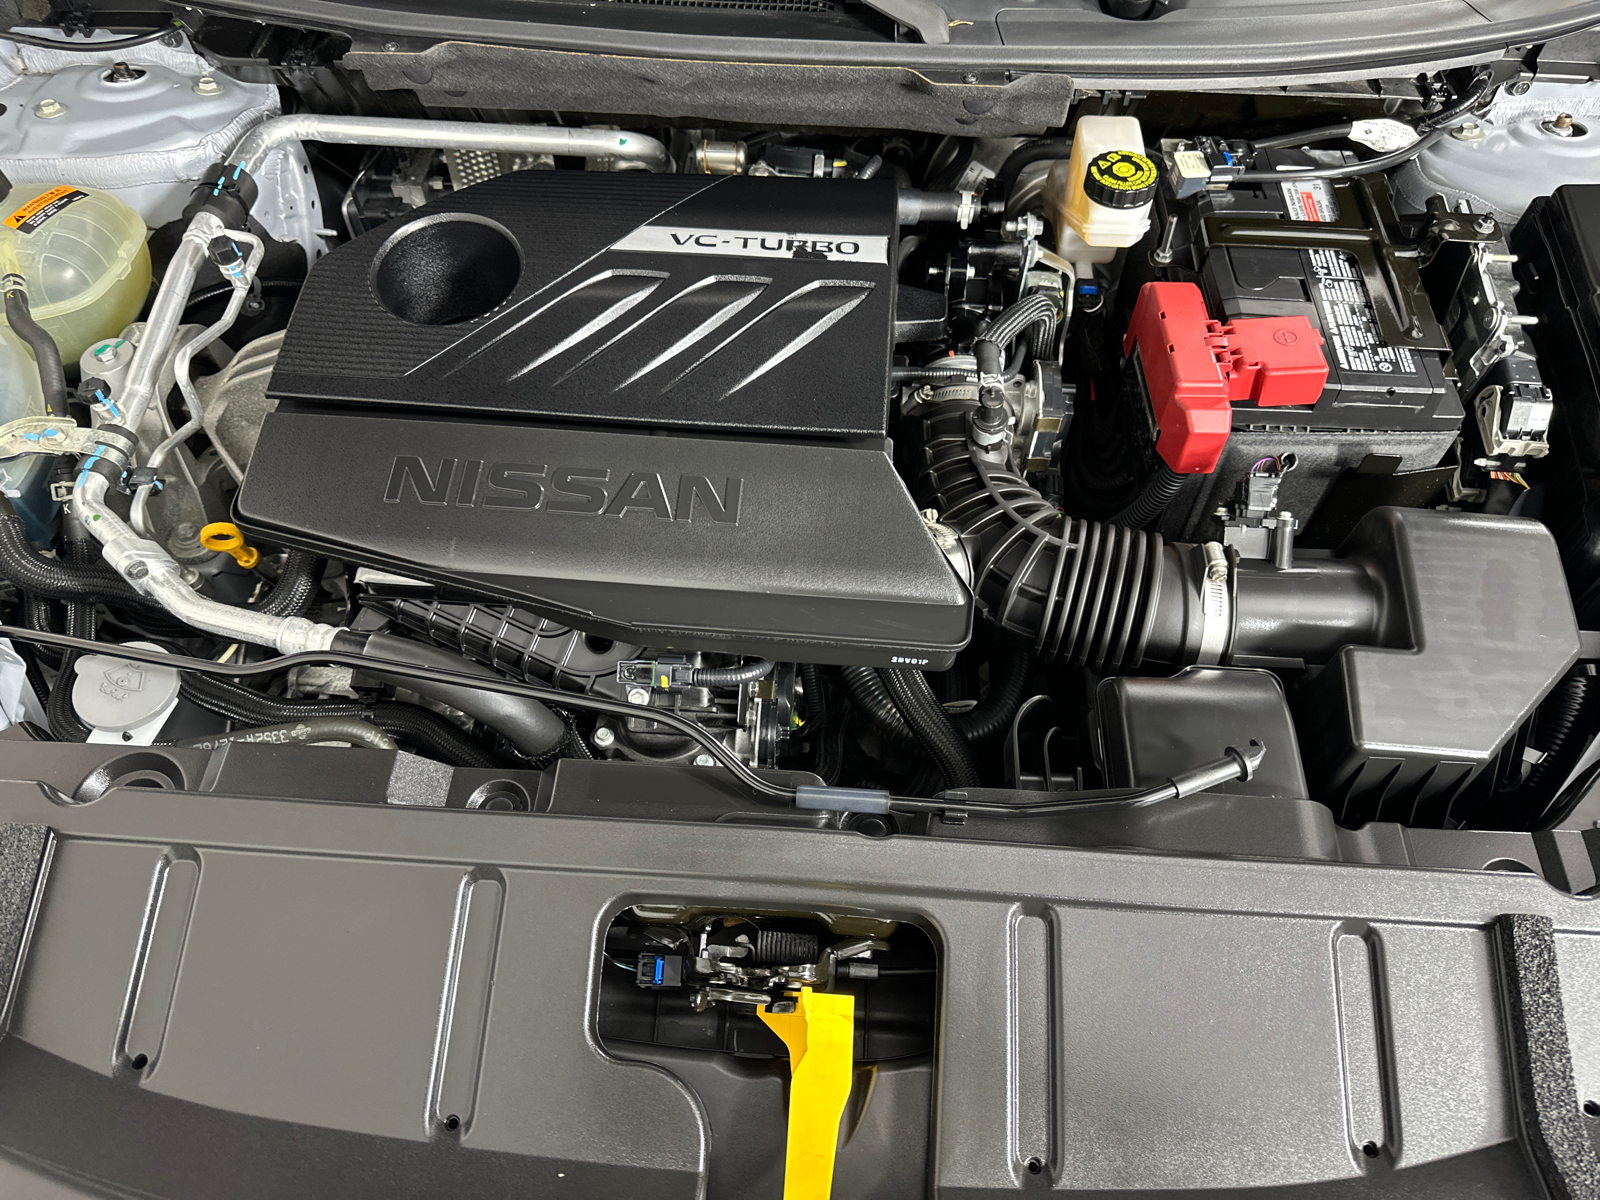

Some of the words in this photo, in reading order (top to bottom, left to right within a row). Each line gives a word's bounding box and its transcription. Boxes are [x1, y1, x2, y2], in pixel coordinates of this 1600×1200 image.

[670, 232, 860, 255] VC-TURBO
[384, 454, 744, 527] NISSAN
[62, 503, 71, 514] K
